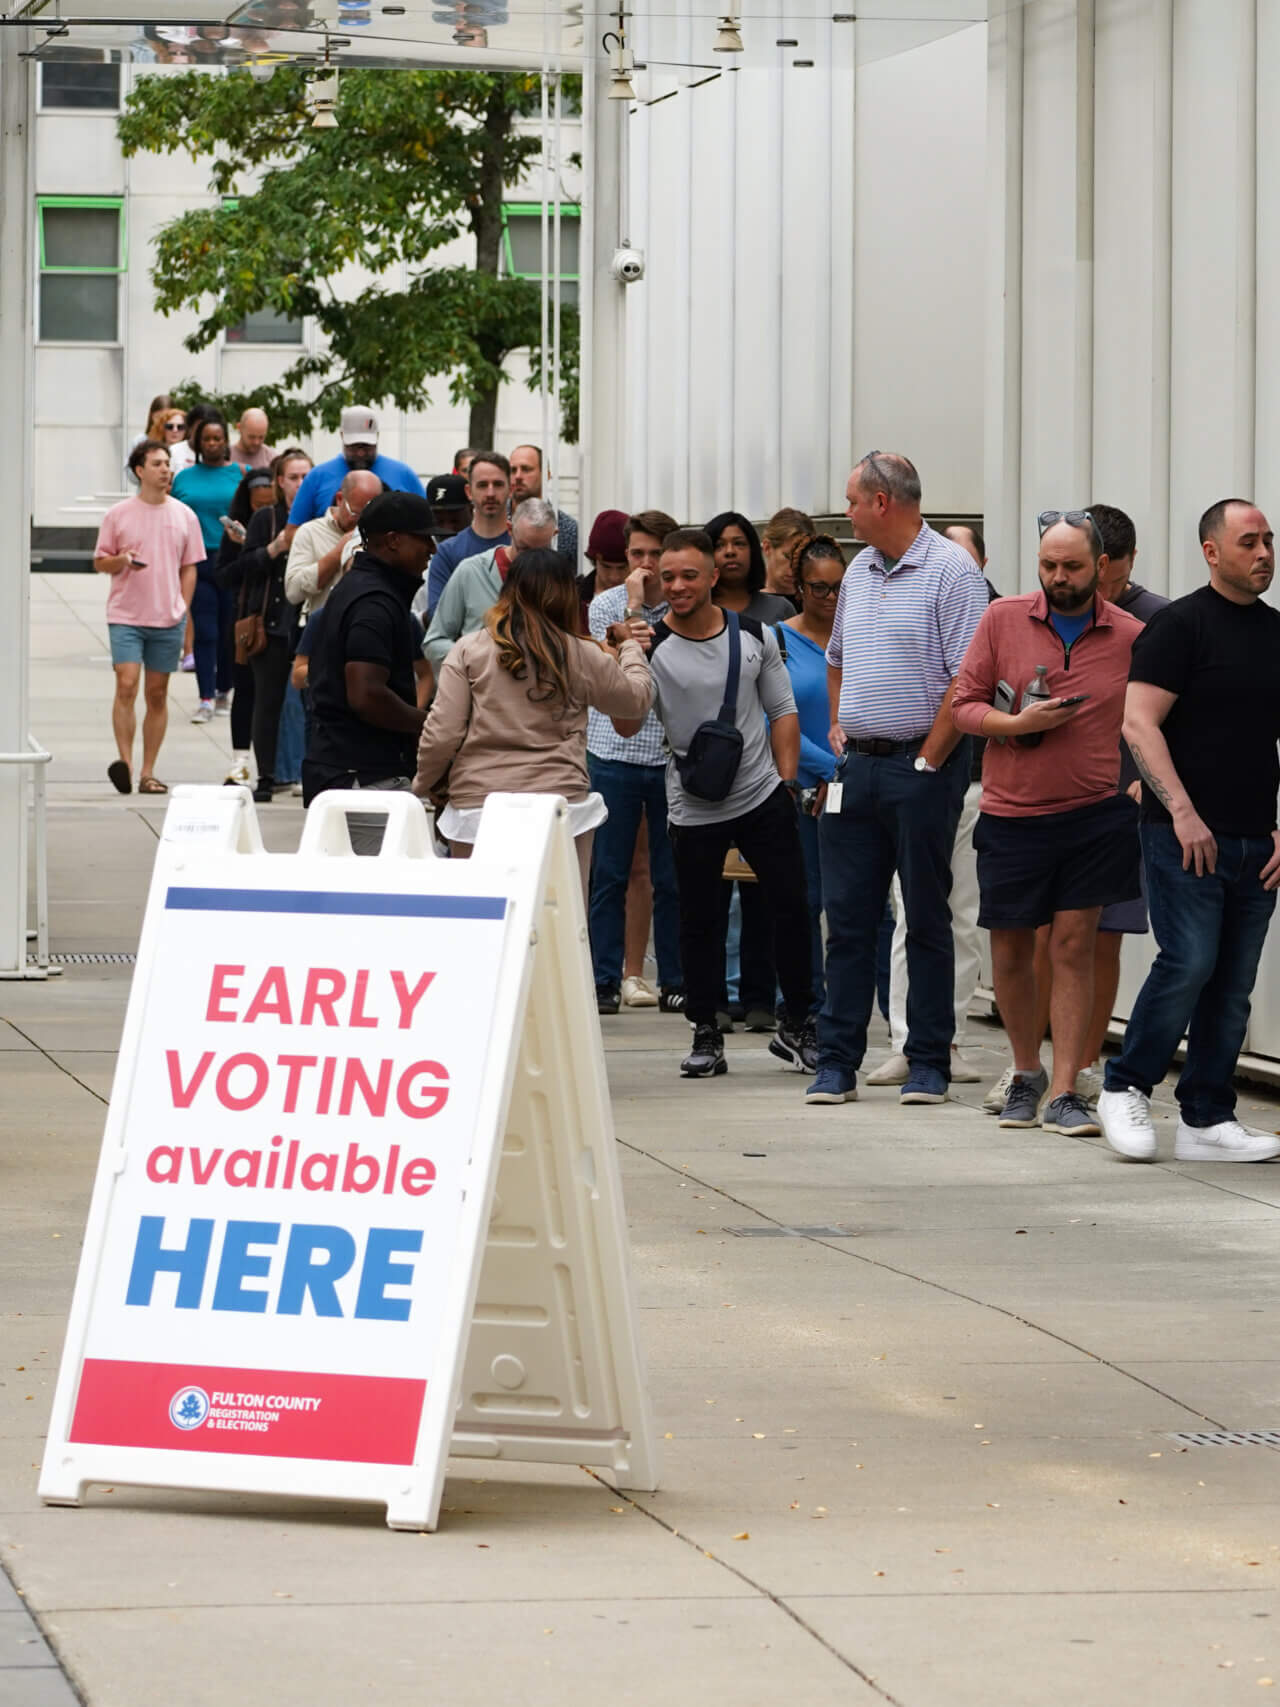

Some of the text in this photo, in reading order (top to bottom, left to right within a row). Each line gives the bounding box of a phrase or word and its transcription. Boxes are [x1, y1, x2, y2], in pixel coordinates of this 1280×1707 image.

[205, 964, 437, 1030] EARLY
[164, 1050, 450, 1119] VOTING
[145, 1136, 437, 1196] available
[125, 1215, 424, 1322] HERE
[206, 1419, 270, 1432] & ELECTIONS
[209, 1408, 280, 1422] REGISTRATION
[212, 1392, 322, 1411] FULTON COUNTY
